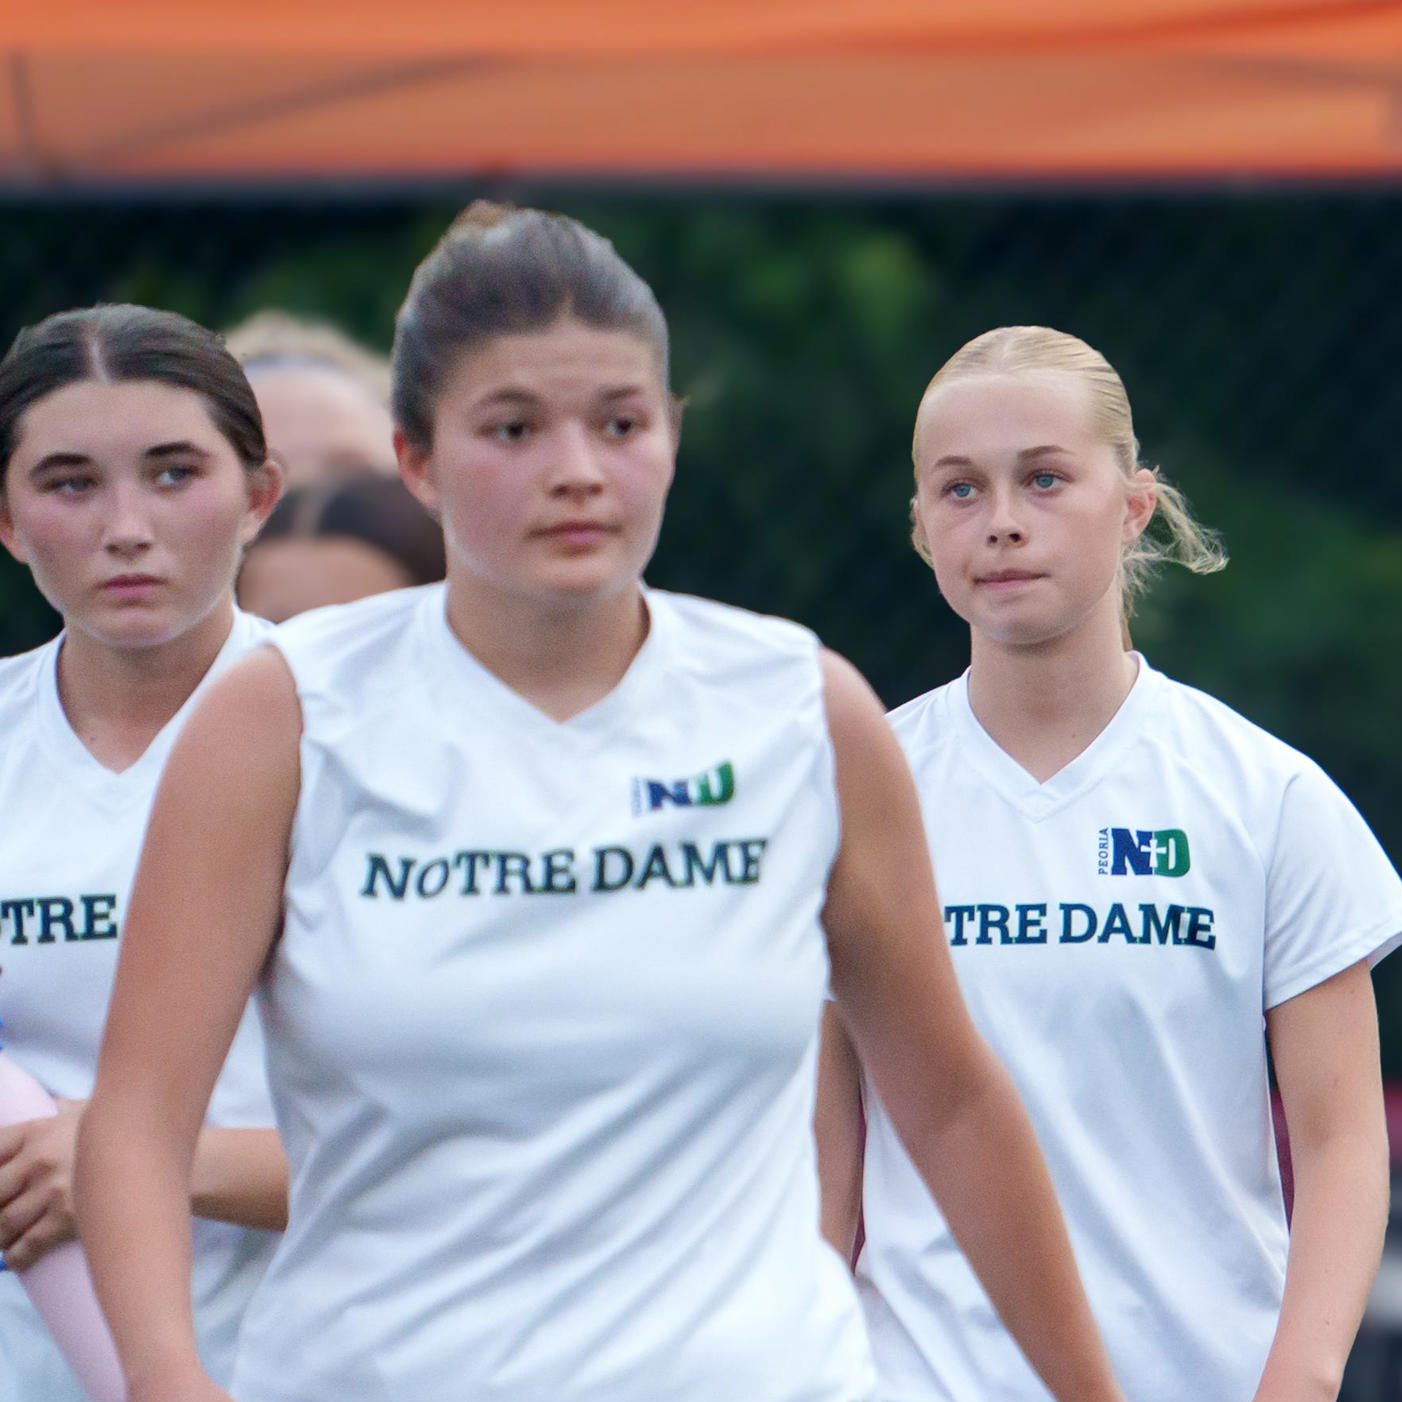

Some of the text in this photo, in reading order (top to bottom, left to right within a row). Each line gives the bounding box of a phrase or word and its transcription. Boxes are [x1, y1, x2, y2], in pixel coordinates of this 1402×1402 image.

[361, 838, 768, 900] NOTRE DAME
[1097, 827, 1109, 875] PEORIA
[1110, 827, 1191, 877] ND
[0, 893, 118, 945] TRE
[944, 903, 1217, 950] TRE DAME
